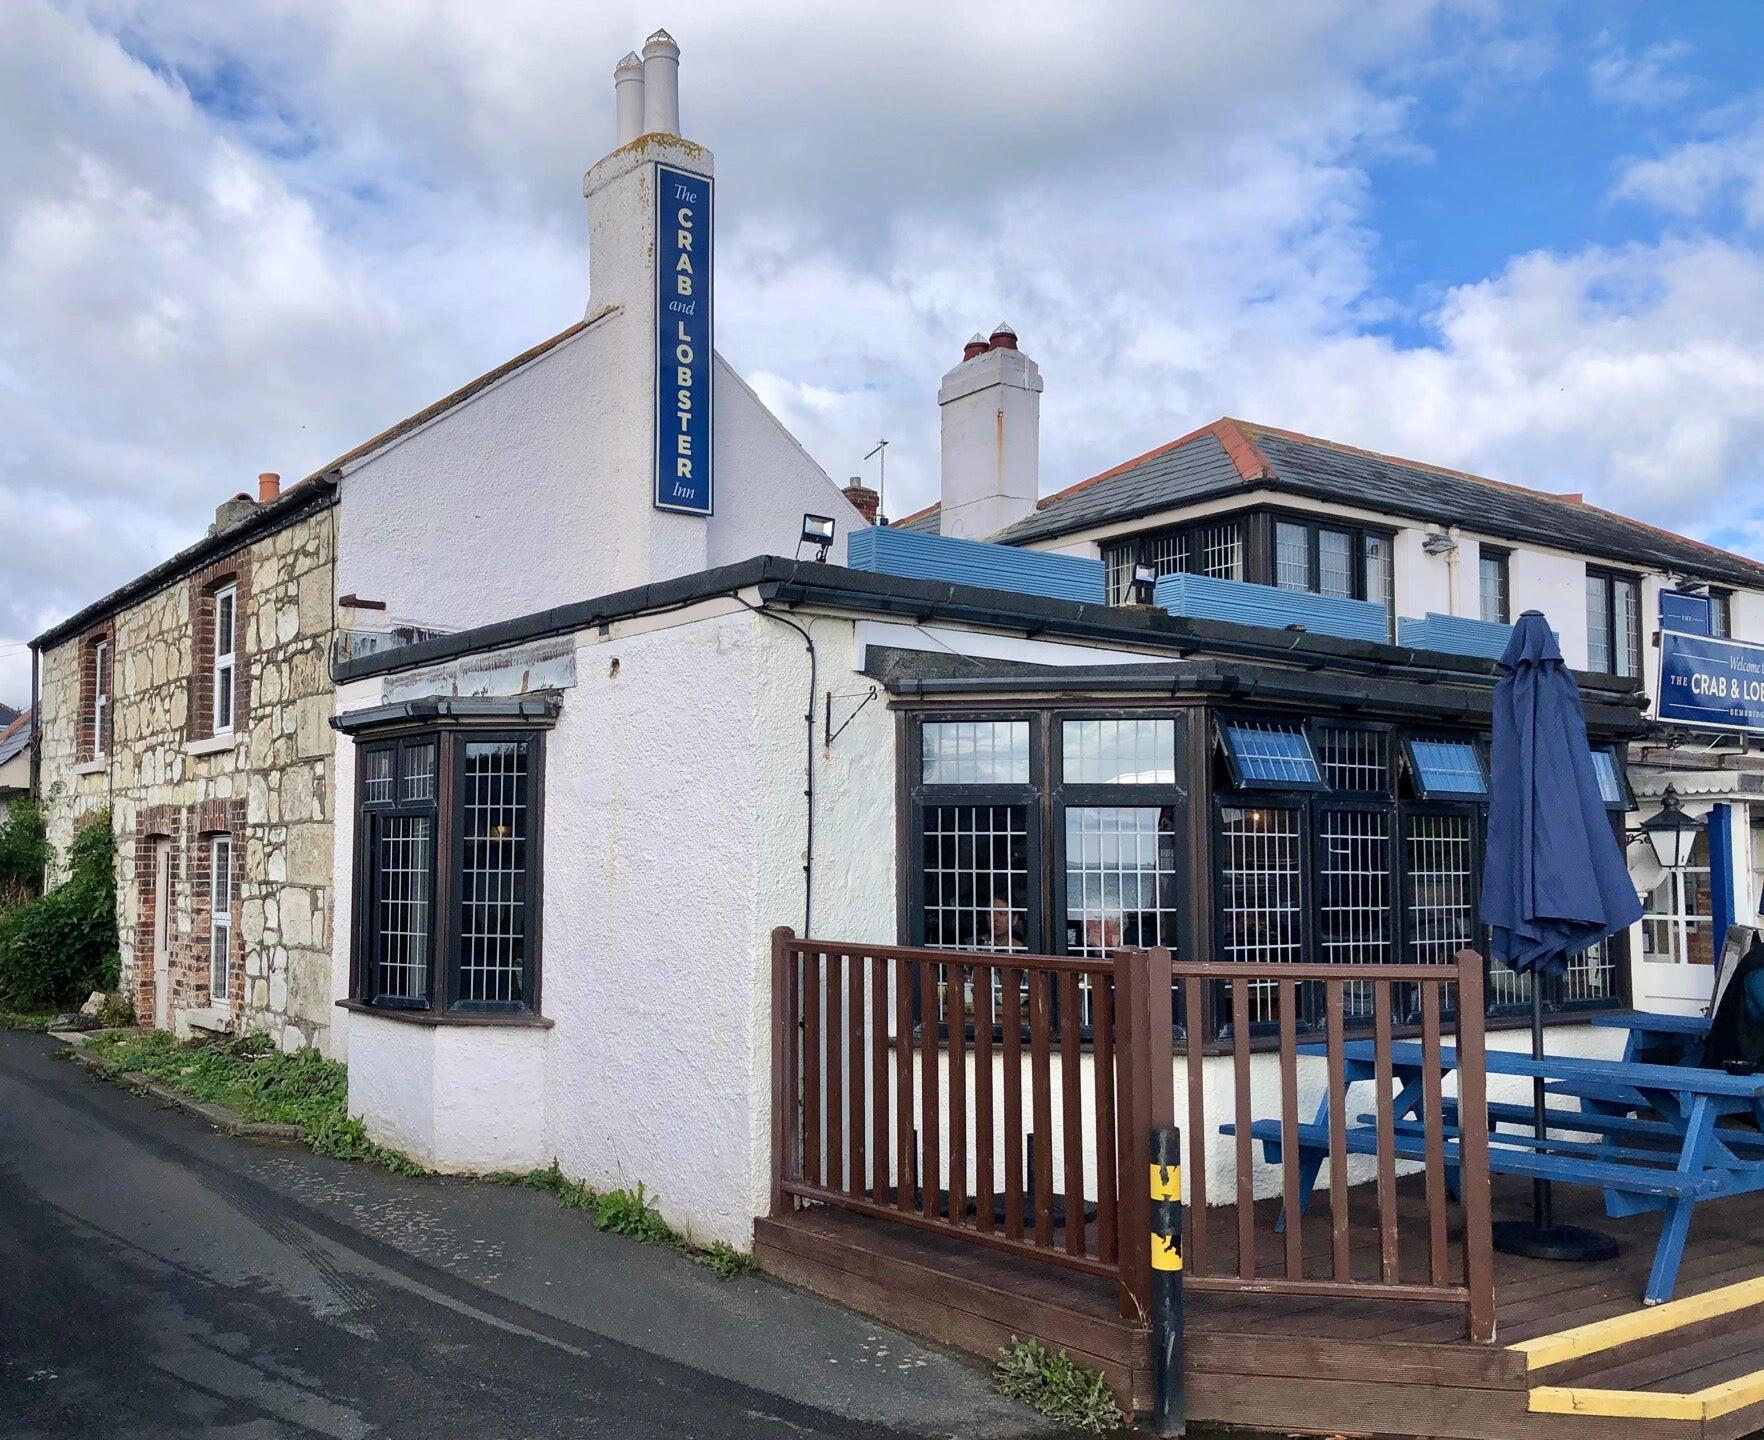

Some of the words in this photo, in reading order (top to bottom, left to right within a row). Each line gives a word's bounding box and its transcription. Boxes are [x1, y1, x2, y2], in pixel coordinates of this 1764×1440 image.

[674, 183, 697, 204] The
[676, 207, 694, 296] CRAB
[669, 300, 696, 316] and
[676, 320, 694, 479] LOBSTER
[672, 481, 695, 499] Inn
[1730, 655, 1760, 674] Welcome
[1670, 675, 1688, 687] THE
[1691, 673, 1727, 698] CRAB
[1730, 678, 1740, 699] &
